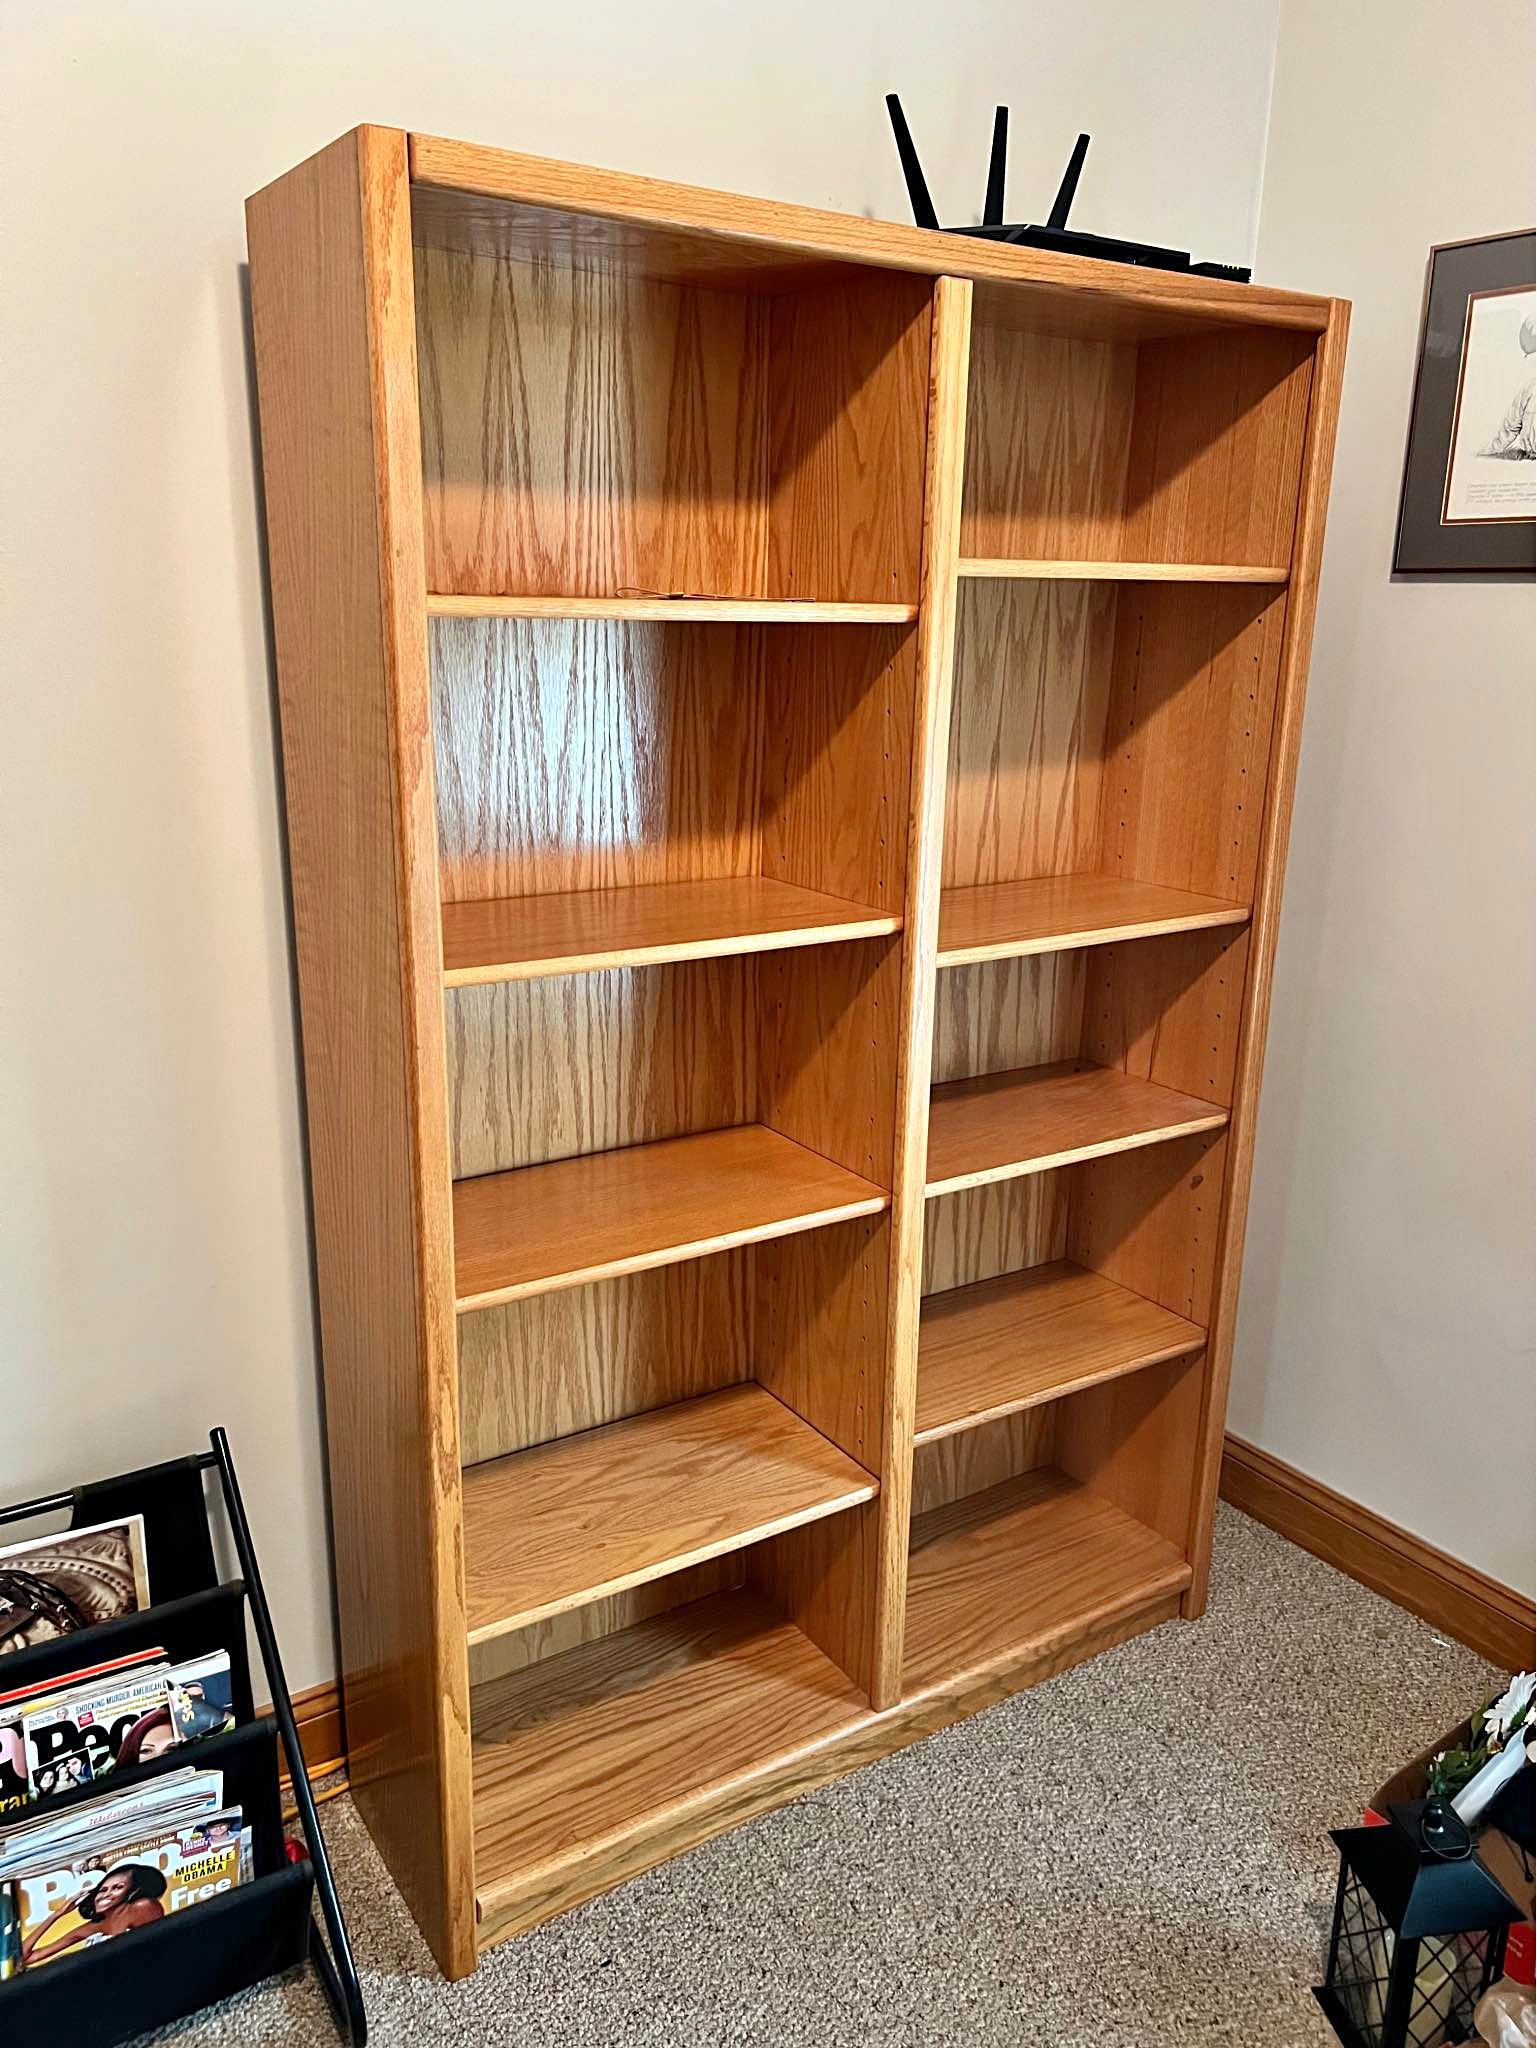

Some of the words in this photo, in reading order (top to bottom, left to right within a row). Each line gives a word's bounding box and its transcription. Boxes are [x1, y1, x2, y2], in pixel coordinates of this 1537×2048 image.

[75, 1699, 106, 1714] SHOCKING
[133, 1682, 162, 1697] AMERICAN
[175, 1852, 232, 1877] MICHELLE
[184, 1863, 223, 1882] OBAMA
[171, 1878, 232, 1912] Free
